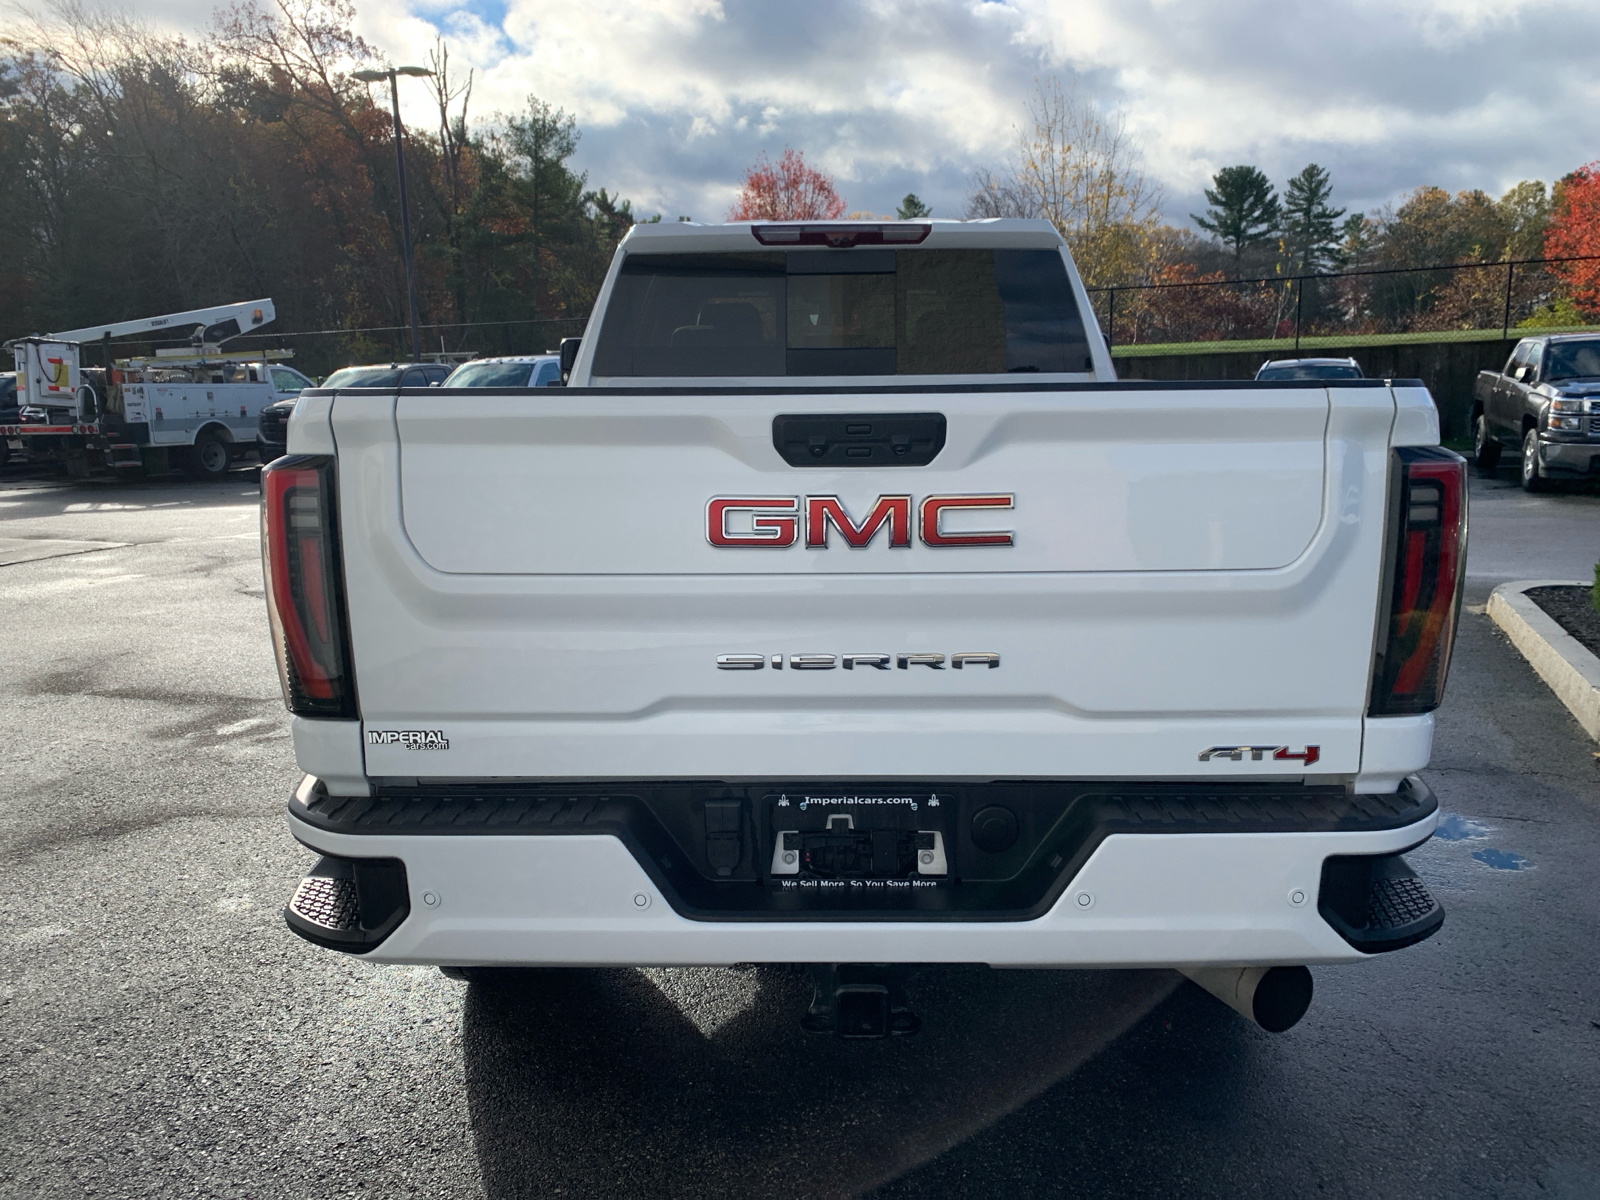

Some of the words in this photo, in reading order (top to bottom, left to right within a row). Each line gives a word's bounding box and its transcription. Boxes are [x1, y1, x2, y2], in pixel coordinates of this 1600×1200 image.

[704, 492, 1015, 550] GMC
[716, 652, 1000, 671] SIERRA
[368, 730, 448, 744] IMPERIAL
[404, 742, 449, 750] cars.com
[1198, 745, 1320, 767] AT4
[804, 796, 913, 806] Imperialcars.com
